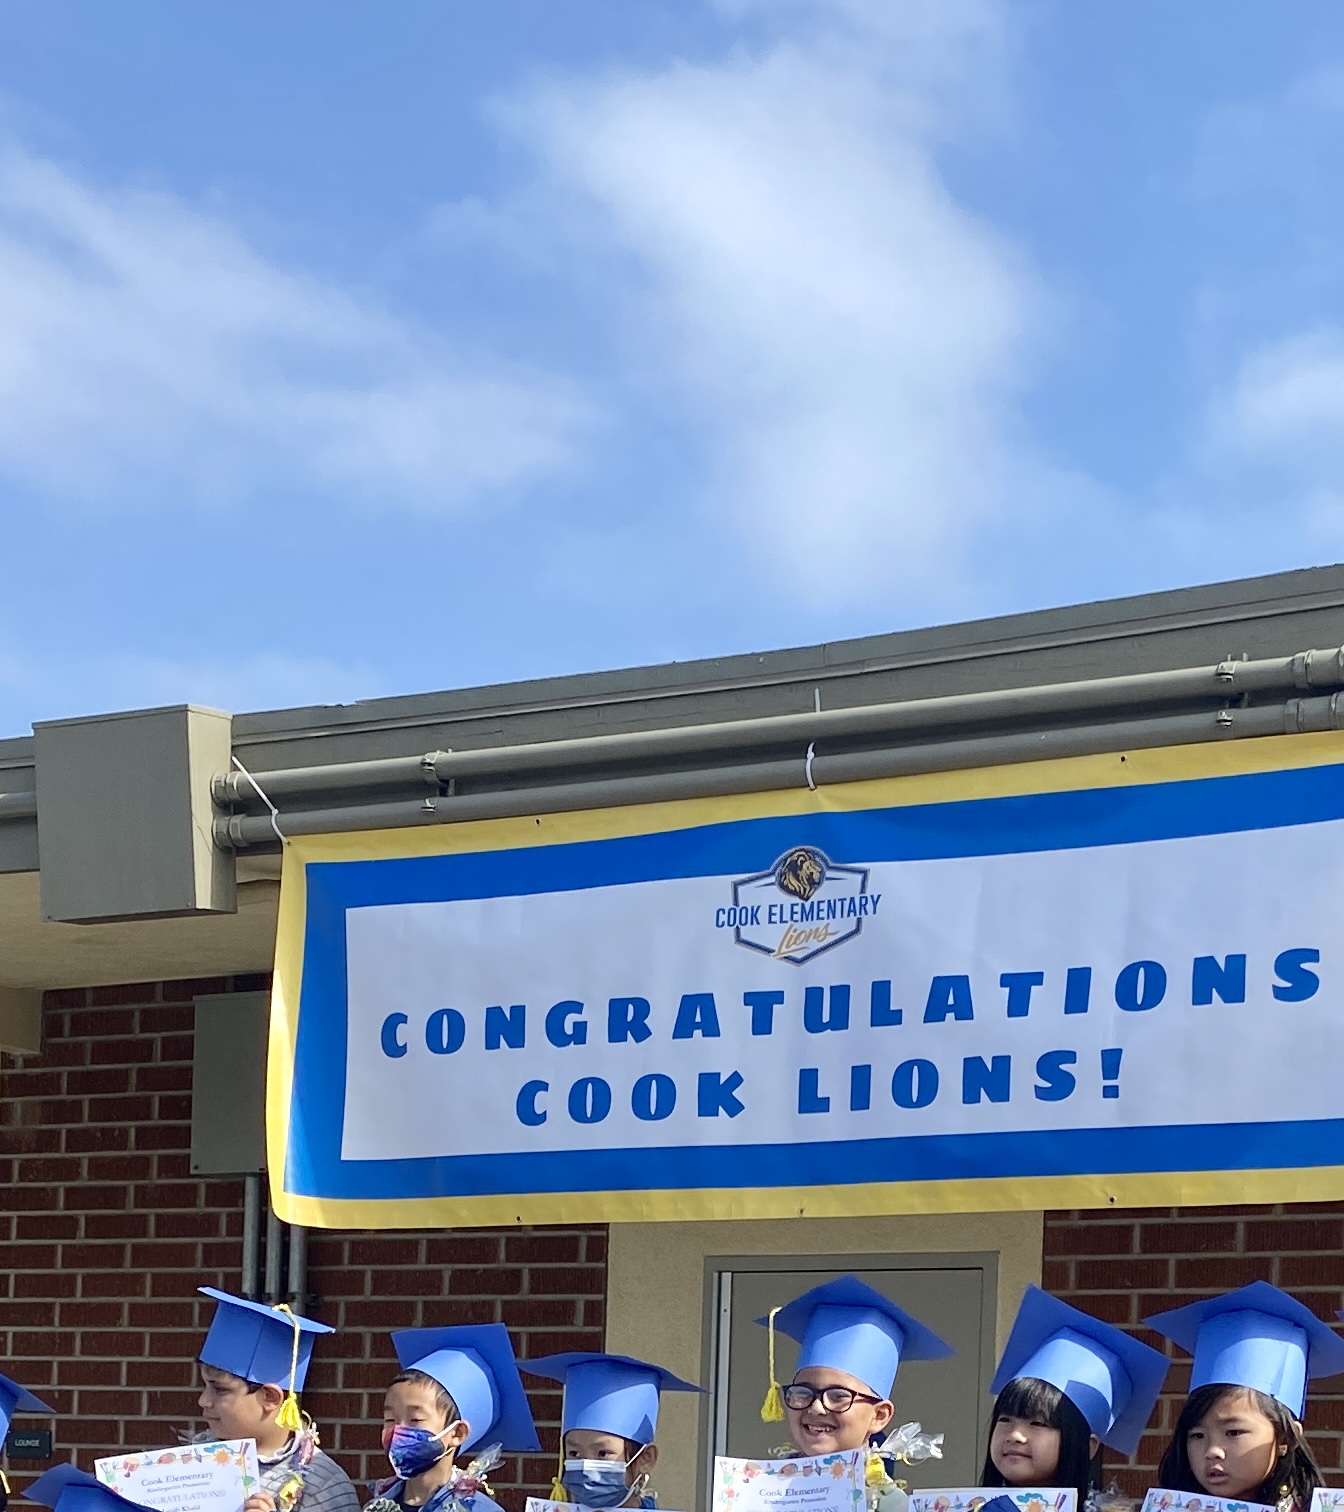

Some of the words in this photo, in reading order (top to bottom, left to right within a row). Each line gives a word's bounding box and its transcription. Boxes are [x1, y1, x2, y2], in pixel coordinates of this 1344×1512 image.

[715, 905, 761, 928] COOK
[768, 894, 882, 924] ELEMENTARY
[771, 923, 840, 957] Lions
[380, 947, 1321, 1059] CONGRATULATIONS
[515, 1071, 747, 1127] COOK
[798, 1048, 1123, 1115] LIONS!
[14, 1439, 40, 1448] LOUNGE
[141, 1477, 163, 1486] Cook
[166, 1471, 214, 1483] Elementary
[759, 1488, 783, 1497] Cook
[785, 1486, 830, 1497] Elementary
